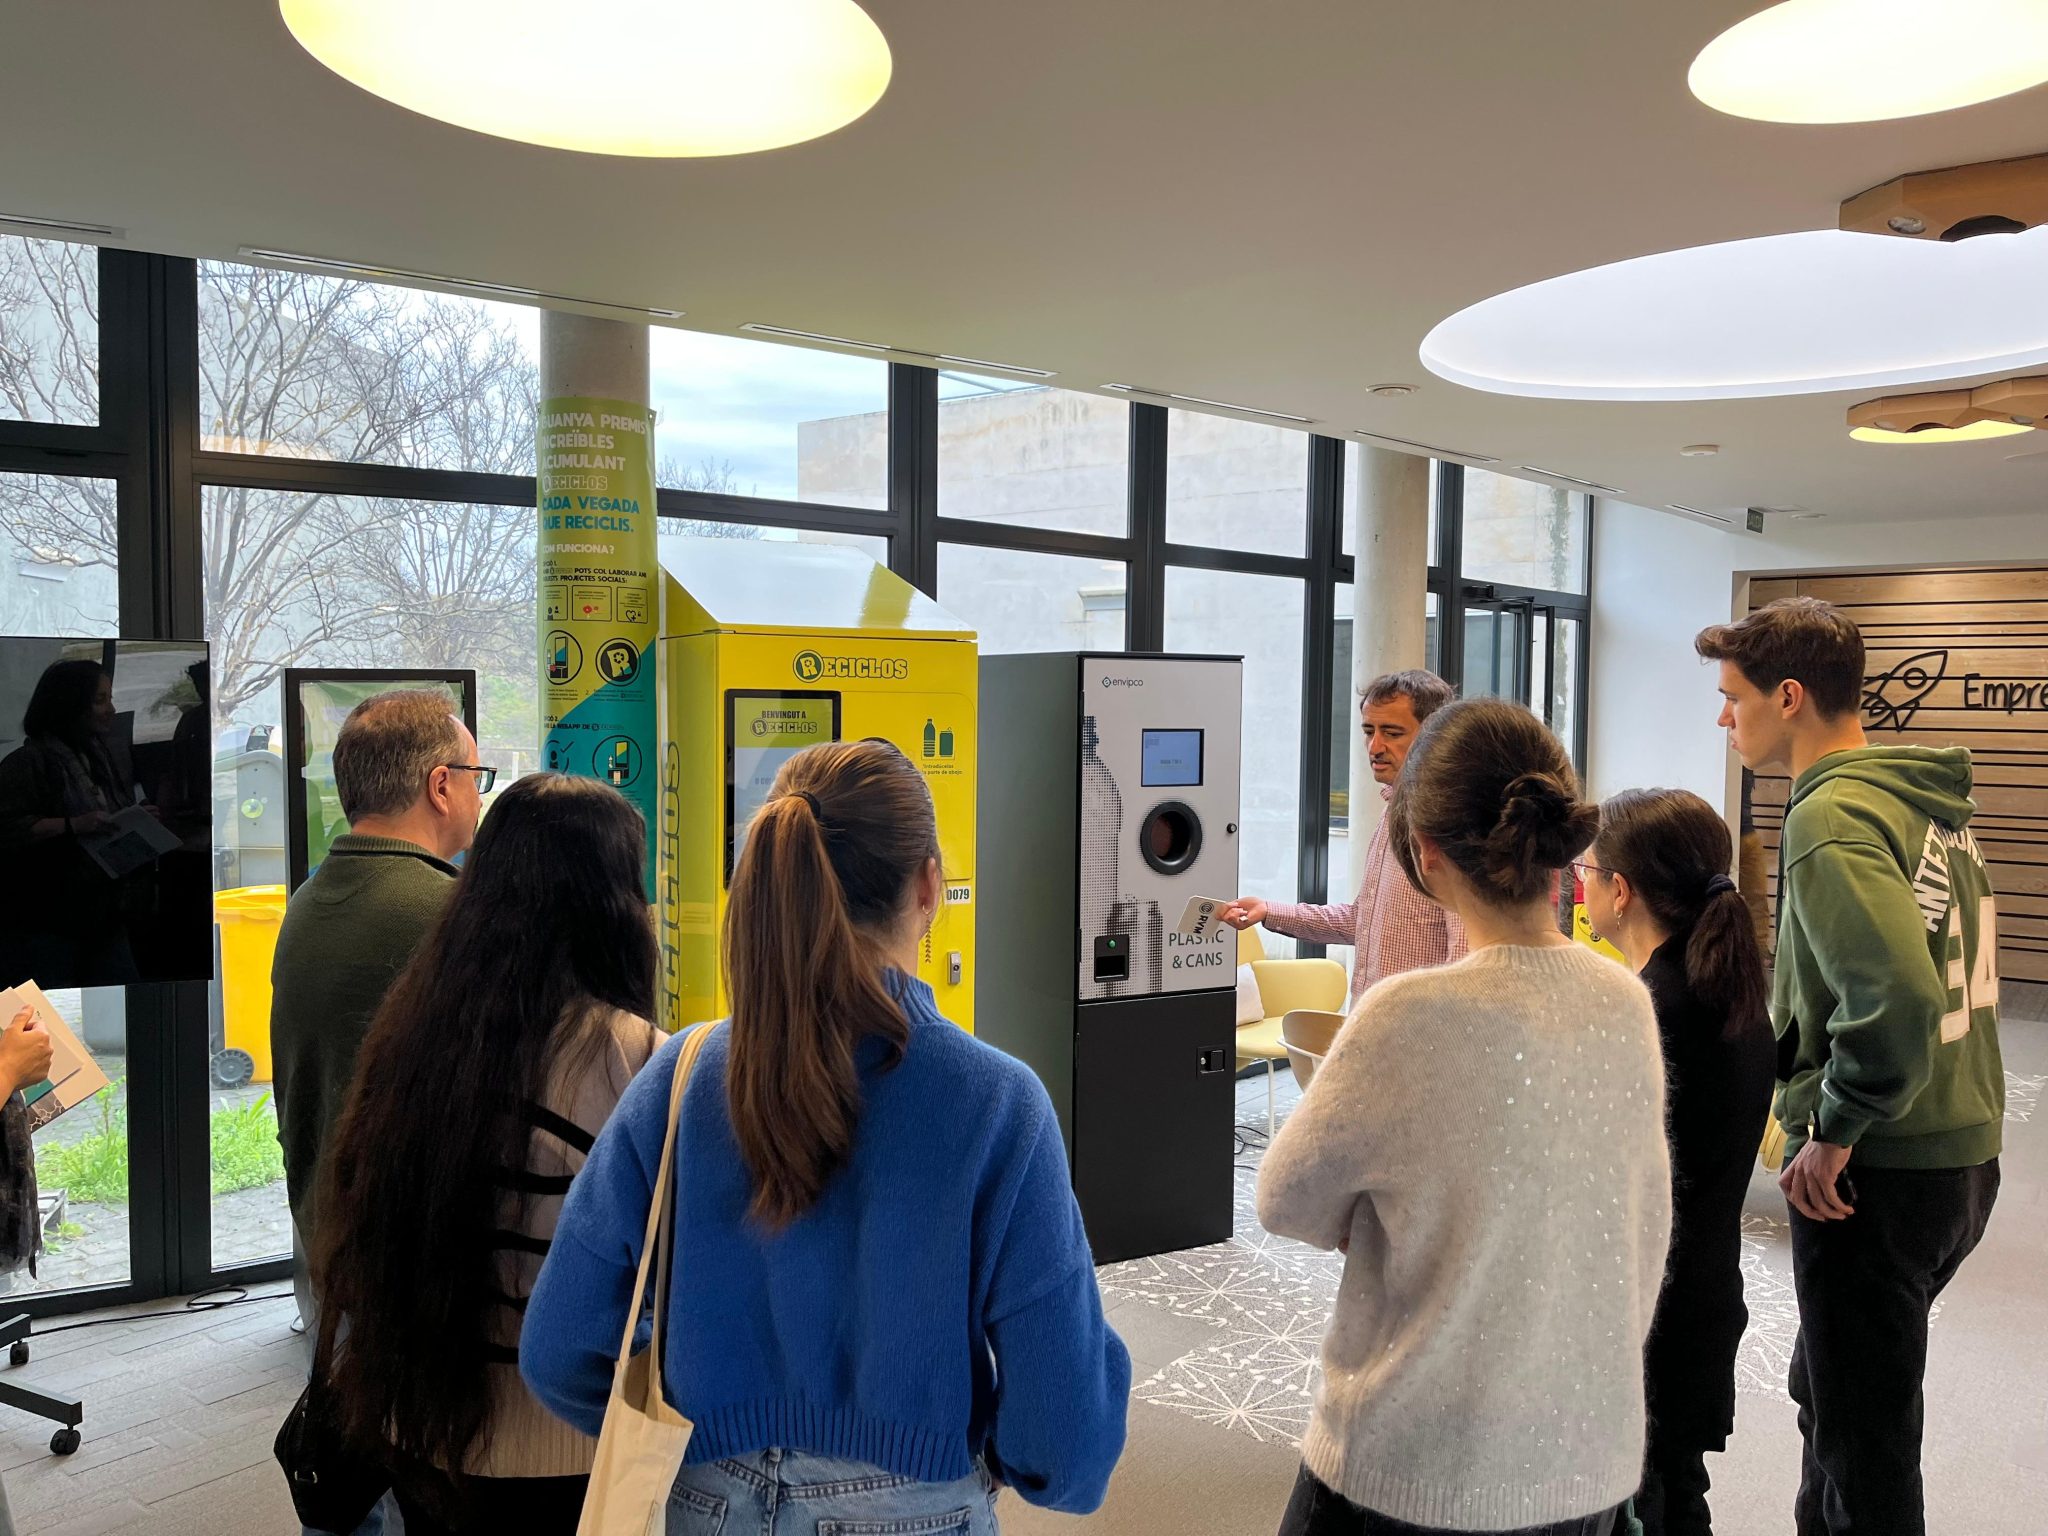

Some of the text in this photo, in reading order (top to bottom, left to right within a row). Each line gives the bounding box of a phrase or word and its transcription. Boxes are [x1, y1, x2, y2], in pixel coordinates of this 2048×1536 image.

[601, 414, 646, 435] PREMIS
[542, 496, 640, 514] CADA VEGADA
[565, 515, 634, 532] RECICLIS.
[556, 543, 615, 554] FUNCIONA?
[793, 649, 908, 683] RECICLOS
[1112, 677, 1144, 688] envipco
[761, 710, 807, 719] BENVINGUT A
[751, 718, 818, 737] RECICLOS
[660, 740, 681, 1031] ECICLOS
[947, 888, 970, 901] 0079
[1193, 915, 1208, 934] RVM
[1172, 952, 1223, 969] & CANS
